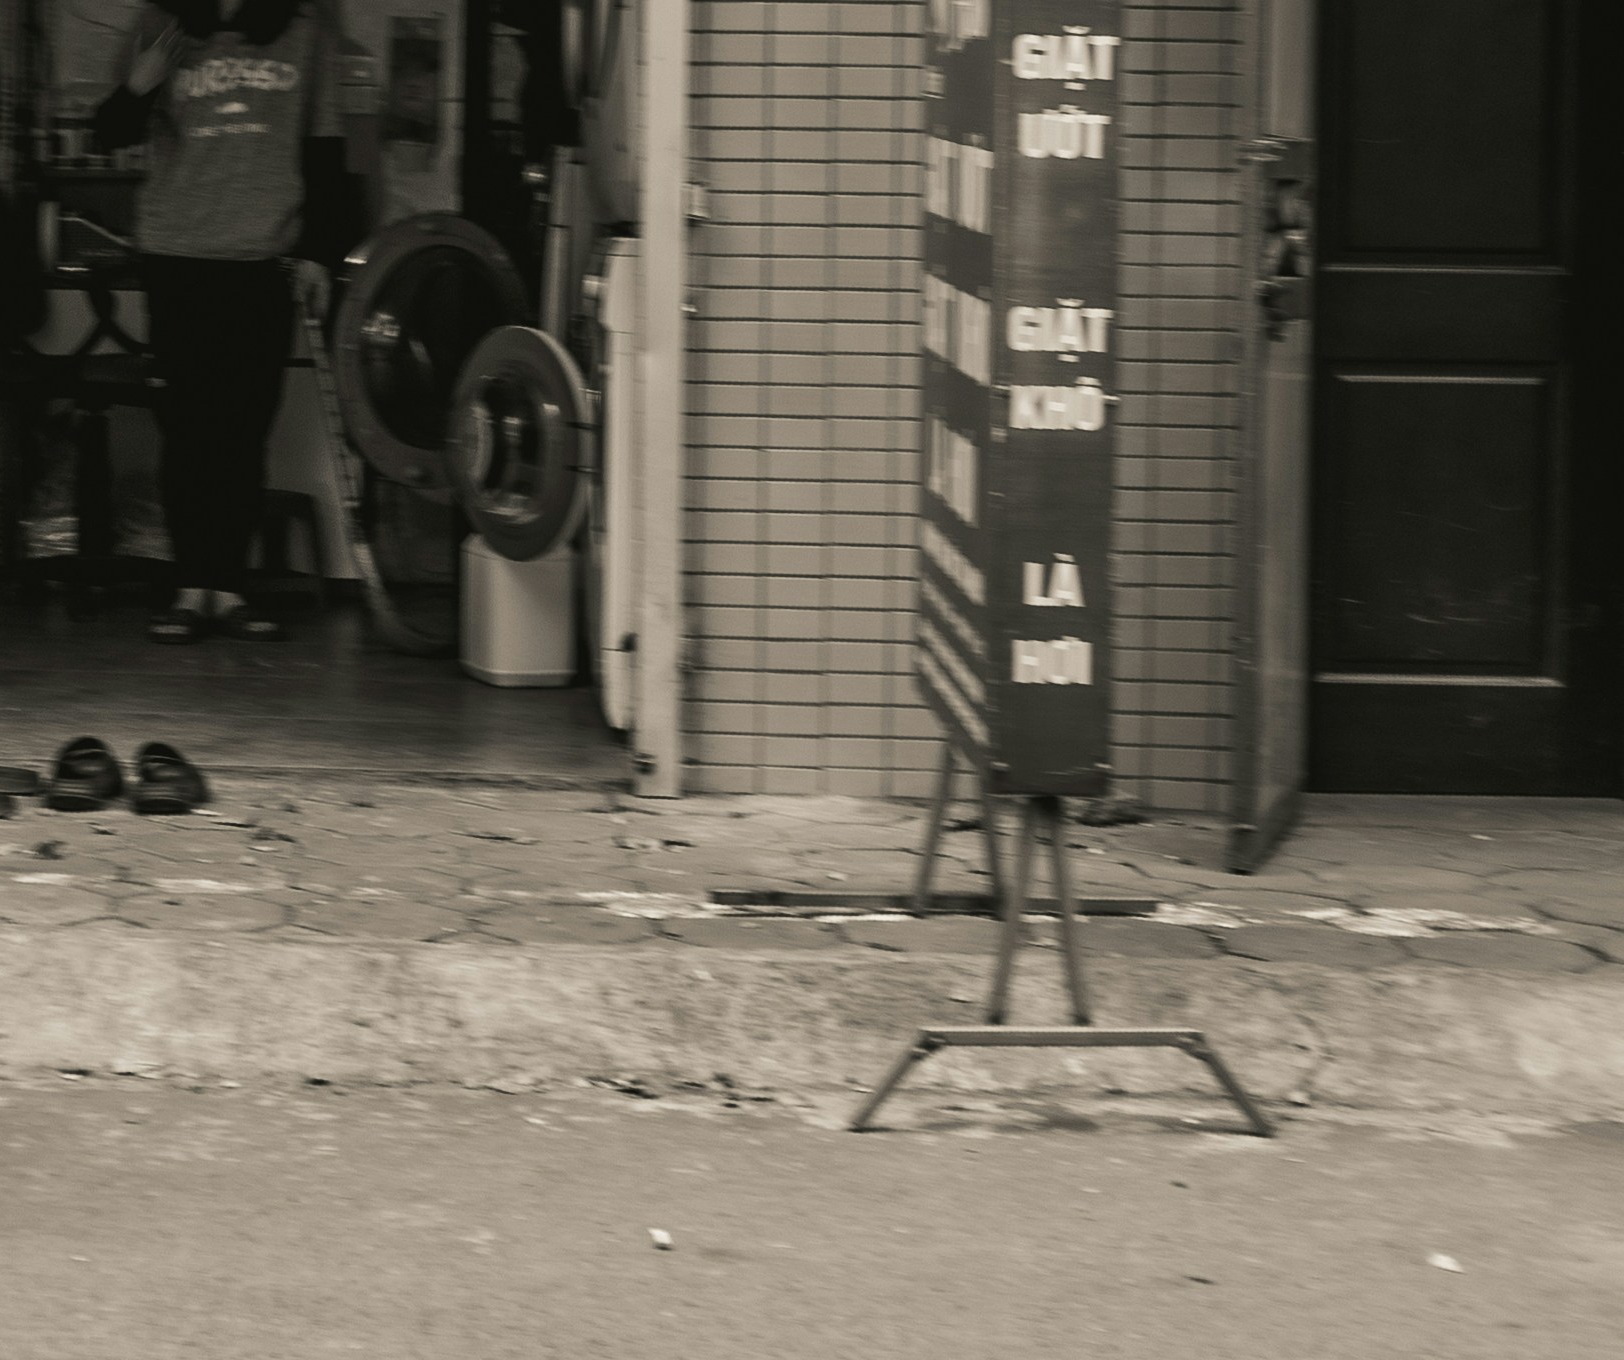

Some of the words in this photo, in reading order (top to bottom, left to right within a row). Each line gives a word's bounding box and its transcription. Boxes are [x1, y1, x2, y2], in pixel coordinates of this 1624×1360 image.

[1011, 26, 1121, 90] GIẶT
[1016, 106, 1113, 159] ƯỚT
[1006, 298, 1114, 362] GIẶT
[1008, 376, 1107, 431] KHÔ
[1022, 552, 1085, 608] LÀ
[1012, 635, 1093, 687] HƠI
